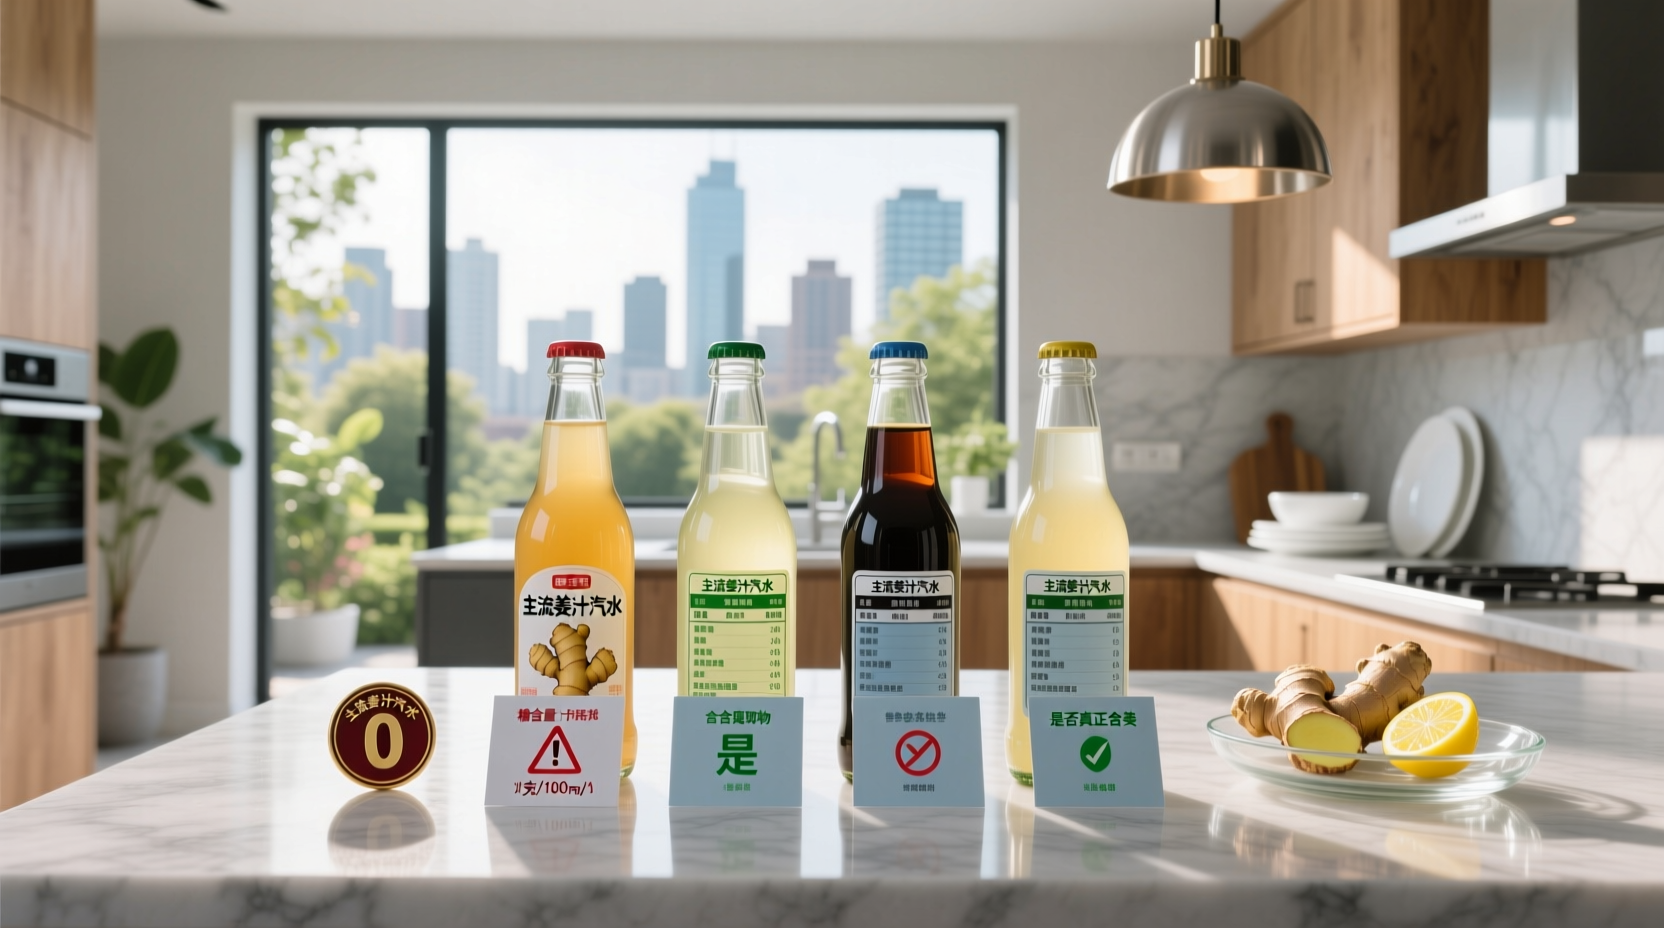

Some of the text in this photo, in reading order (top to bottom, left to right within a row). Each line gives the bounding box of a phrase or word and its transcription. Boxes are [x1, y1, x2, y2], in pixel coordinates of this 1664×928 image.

[522, 594, 623, 617] 主流姜汁汽水
[364, 712, 404, 770] 0
[715, 733, 758, 776] 是
